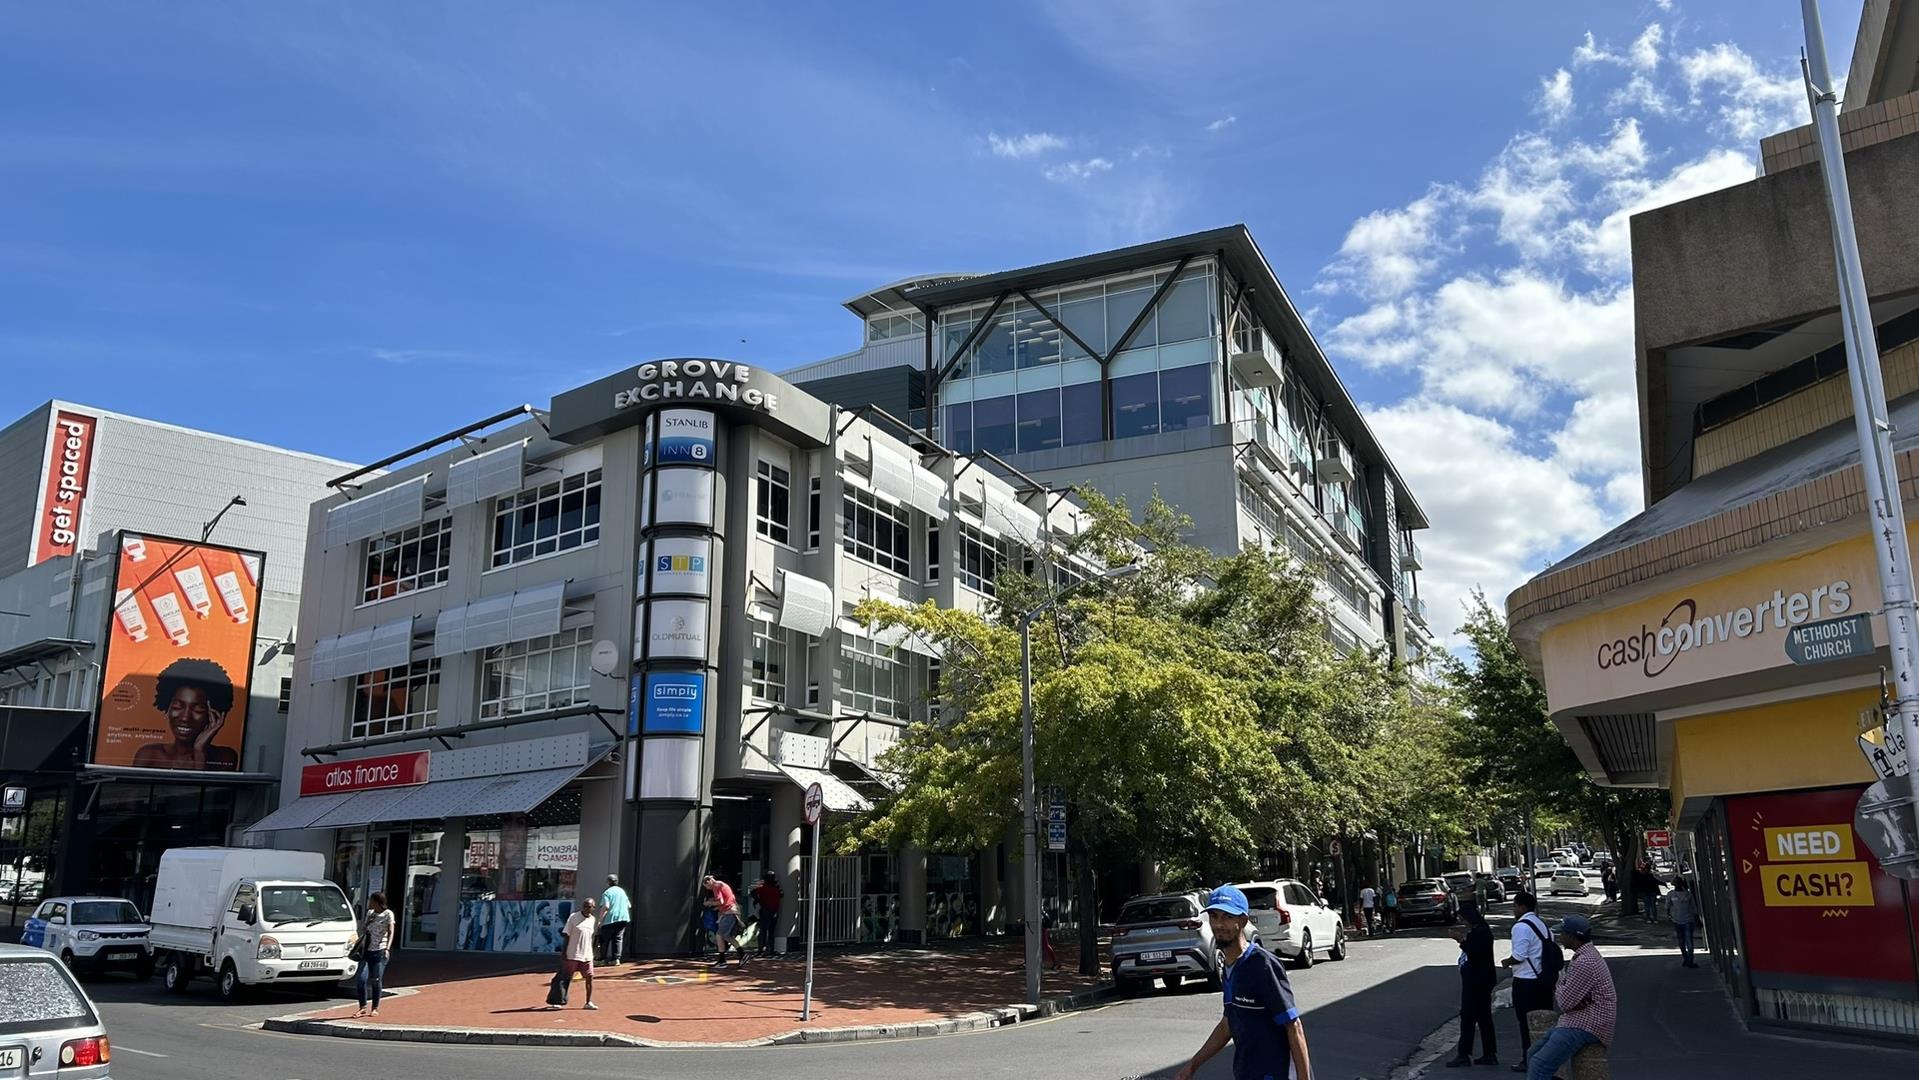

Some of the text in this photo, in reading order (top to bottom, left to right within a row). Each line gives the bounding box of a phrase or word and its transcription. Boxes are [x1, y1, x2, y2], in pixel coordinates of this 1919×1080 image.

[637, 360, 749, 382] GROVE
[615, 381, 777, 411] EXCHANGE
[665, 418, 709, 429] STANLIB
[53, 421, 84, 544] get spaced
[657, 556, 704, 571] STP
[1793, 619, 1857, 644] METHODIST
[1804, 640, 1852, 660] CHURCH
[656, 686, 698, 697] simply
[325, 763, 399, 787] atlas finance
[1777, 830, 1841, 856] NEED
[1776, 873, 1854, 897] CASH?
